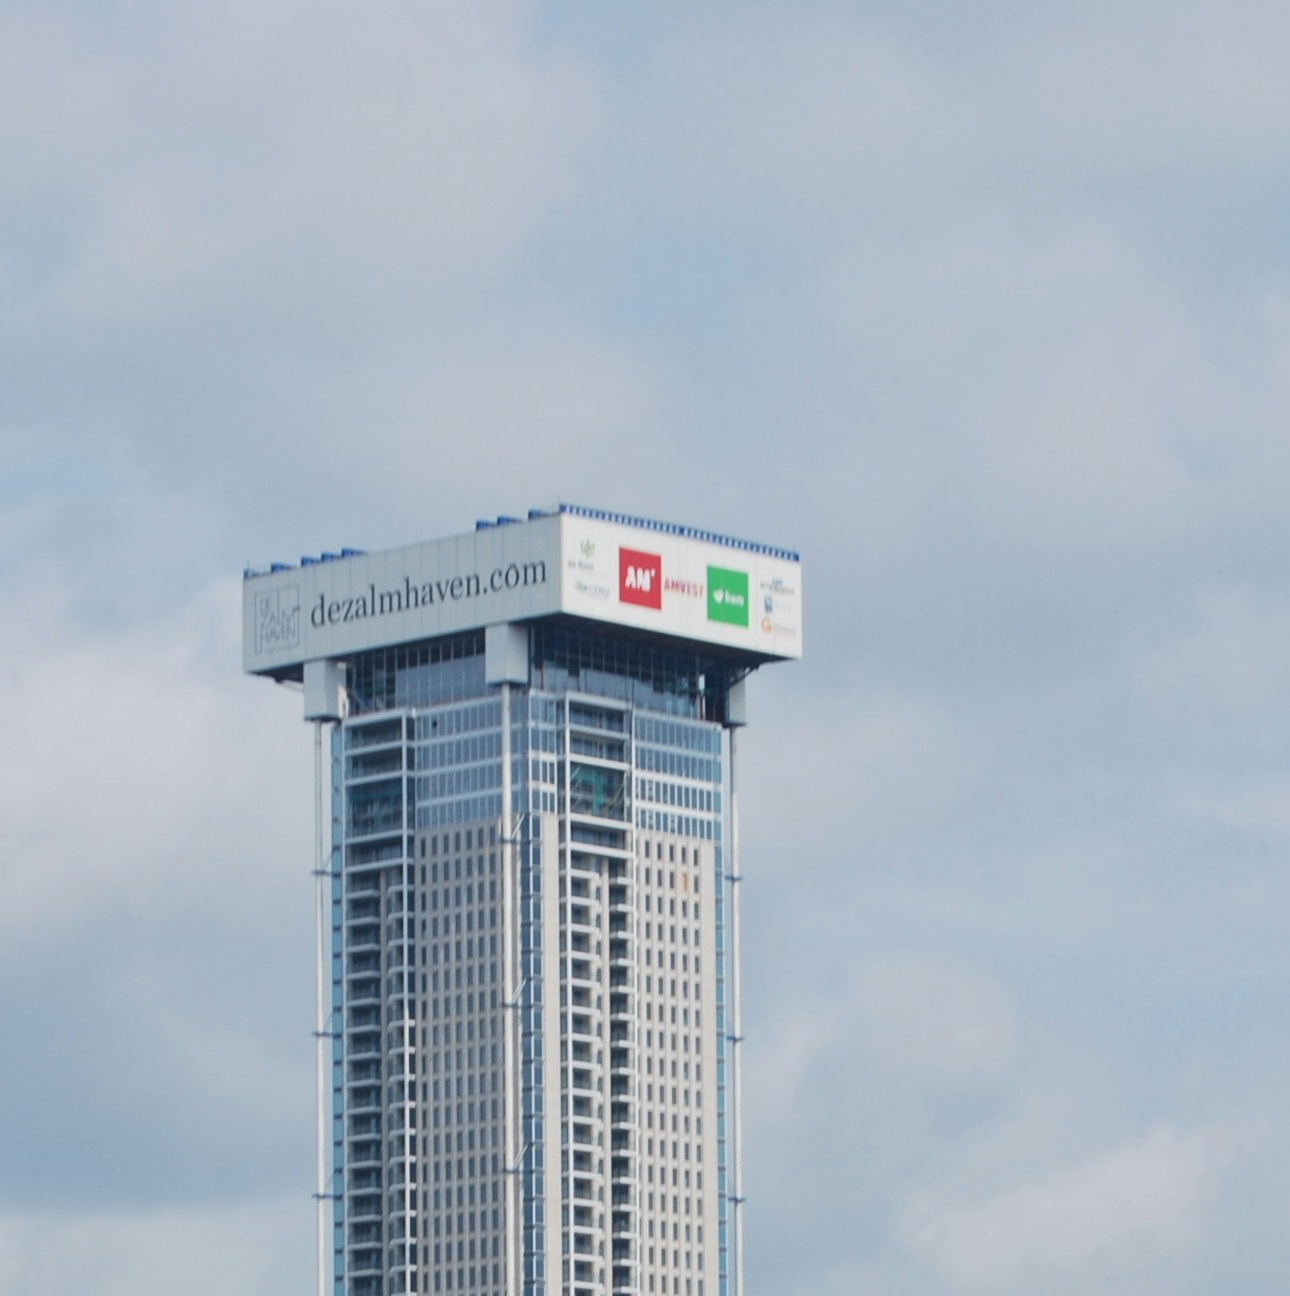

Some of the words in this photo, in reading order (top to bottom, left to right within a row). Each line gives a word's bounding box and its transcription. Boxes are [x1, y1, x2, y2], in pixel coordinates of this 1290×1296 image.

[310, 558, 547, 629] dezalmhaven.com
[664, 578, 704, 599] AMVEST
[724, 589, 745, 608] bam
